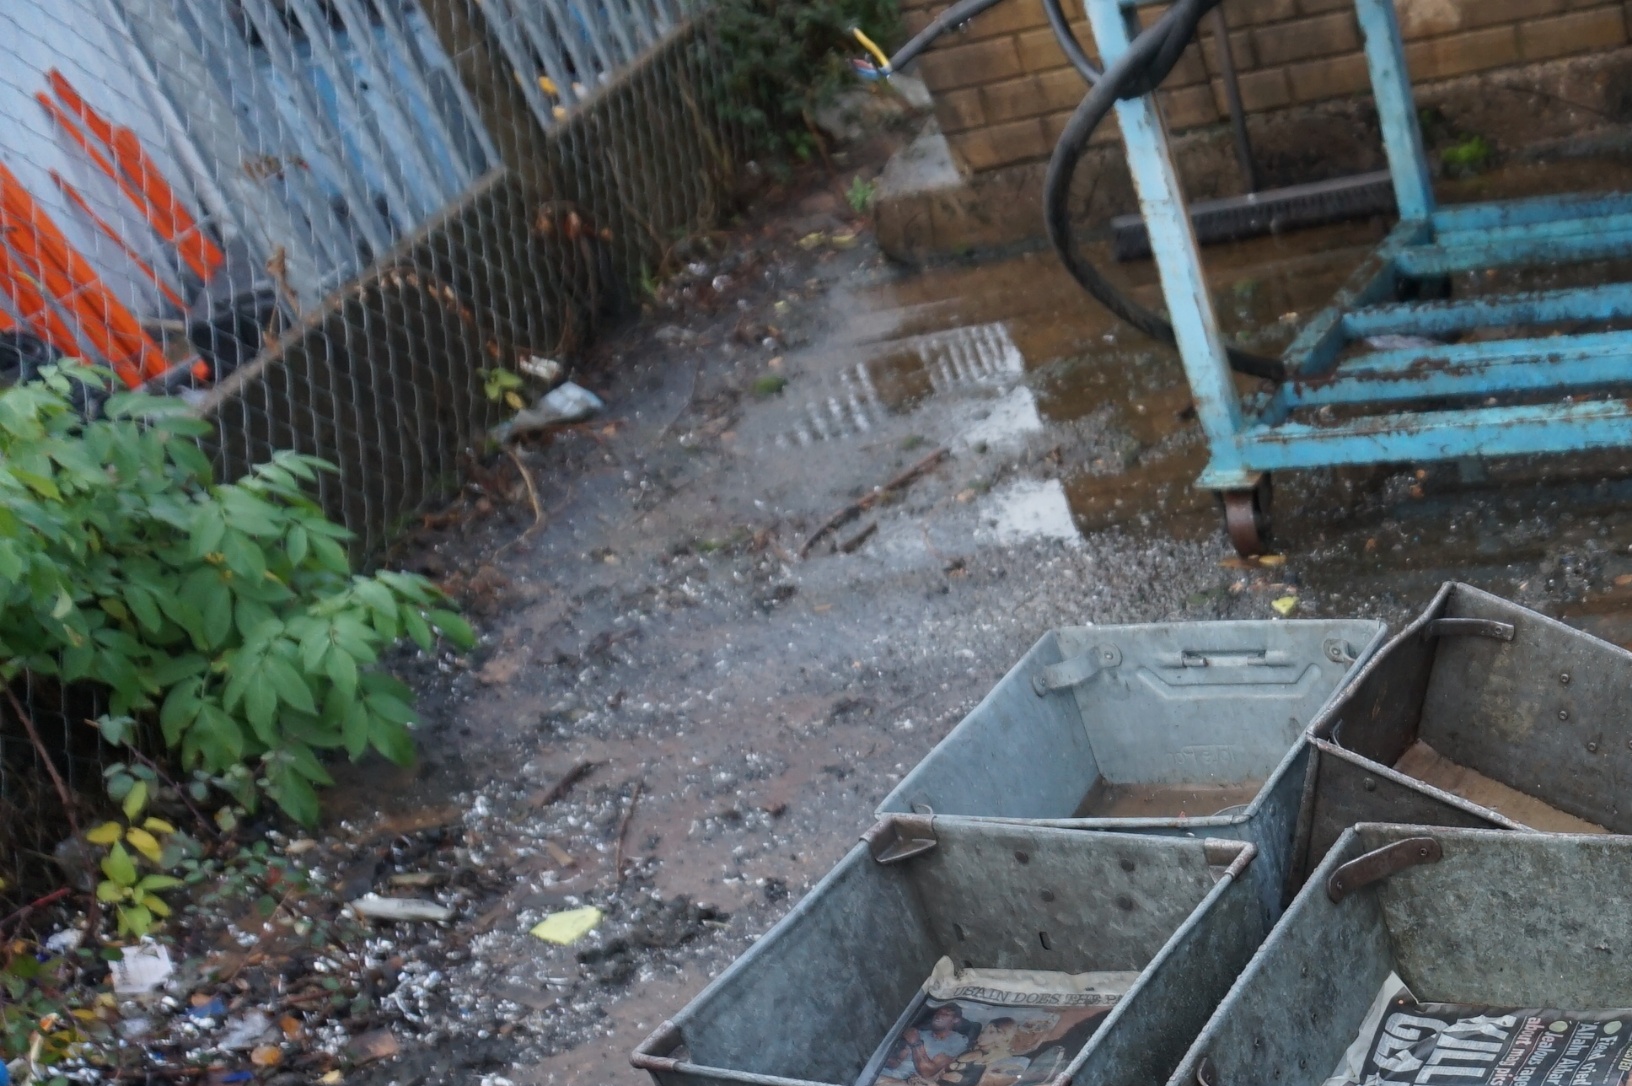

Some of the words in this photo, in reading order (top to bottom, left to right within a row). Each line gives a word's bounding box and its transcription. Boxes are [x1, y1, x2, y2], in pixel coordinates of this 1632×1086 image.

[954, 985, 1012, 1003] USAIN
[1011, 992, 1064, 1006] DOES
[1515, 1017, 1544, 1045] about
[1499, 1048, 1525, 1066] mag
[1528, 1031, 1564, 1065] Jealous
[1587, 1035, 1618, 1061] Fiend
[1490, 1068, 1513, 1086] pics
[1572, 1063, 1597, 1086] cried
